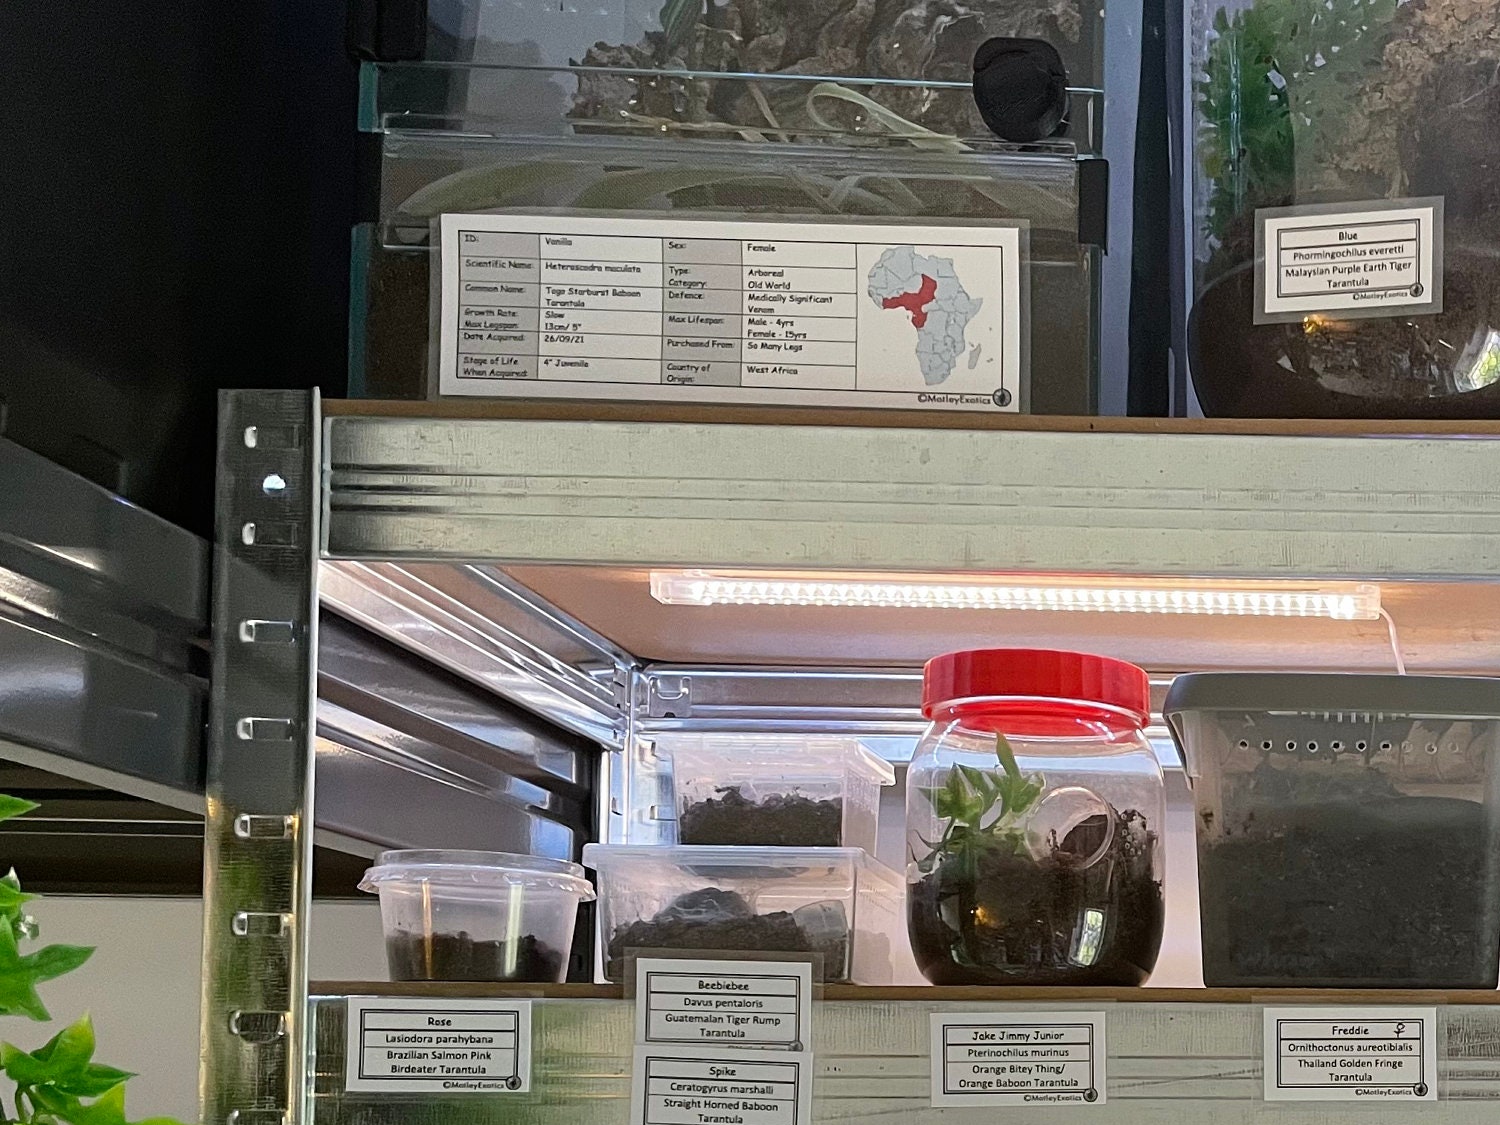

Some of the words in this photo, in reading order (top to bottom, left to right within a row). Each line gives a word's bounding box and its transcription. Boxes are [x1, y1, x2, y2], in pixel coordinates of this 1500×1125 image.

[1339, 232, 1358, 240] Blue
[747, 244, 776, 253] Female
[1293, 246, 1367, 261] Phormingochilus
[1286, 267, 1330, 278] Malaysian
[1332, 266, 1361, 275] Purple
[1363, 263, 1387, 272] Earth
[1389, 261, 1412, 272] Tiger
[748, 281, 764, 289] Old
[767, 282, 791, 290] World
[1327, 278, 1369, 288] Tarantula
[748, 294, 787, 303] Medically
[789, 295, 833, 305] Significant
[544, 335, 584, 344] 26/09/21
[747, 342, 759, 350] So
[760, 343, 782, 353] Many
[783, 343, 803, 352] Legs
[747, 366, 769, 375] West
[771, 367, 798, 375] Africa
[698, 981, 750, 990] Beebiebee
[684, 998, 713, 1006] Davus
[715, 999, 763, 1008] pentaloris
[428, 1017, 452, 1026] Rose
[665, 1014, 724, 1024] Guatemalan
[727, 1015, 750, 1025] Tiger
[753, 1016, 780, 1026] Rump
[700, 1028, 745, 1038] Tarantula
[1332, 1026, 1369, 1035] Freddie
[385, 1034, 433, 1043] Lasiodora
[436, 1035, 493, 1044] parahybana
[972, 1032, 996, 1040] Jake
[999, 1031, 1030, 1042] Jimmy
[1033, 1031, 1064, 1040] Junior
[1288, 1044, 1354, 1052] Ornithoctonus
[1357, 1043, 1413, 1052] aureotibialis
[387, 1051, 428, 1060] Brazilian
[431, 1051, 468, 1060] Salmon
[470, 1052, 492, 1060] Pink
[968, 1049, 1028, 1057] Pterinochilus
[1031, 1049, 1069, 1057] murinus
[972, 1065, 1007, 1074] Orange
[1009, 1065, 1033, 1074] Bitey
[1035, 1064, 1065, 1073] Thing/
[1298, 1059, 1337, 1068] Thailand
[1339, 1059, 1372, 1068] Golden
[1375, 1059, 1403, 1069] Fringe
[391, 1065, 436, 1073] Birdeater
[439, 1065, 486, 1074] Tarantula
[709, 1067, 736, 1078] Spike
[1329, 1073, 1372, 1082] Tarantula
[670, 1082, 728, 1093] Ceratogyrus
[730, 1086, 774, 1094] marshalli
[959, 1079, 993, 1089] Orange
[996, 1079, 1032, 1087] Baboon
[1034, 1078, 1078, 1087] Tarantula
[664, 1099, 701, 1110] Straight
[704, 1100, 739, 1110] Horned
[742, 1102, 778, 1111] Baboon
[698, 1114, 743, 1124] Tarantula
